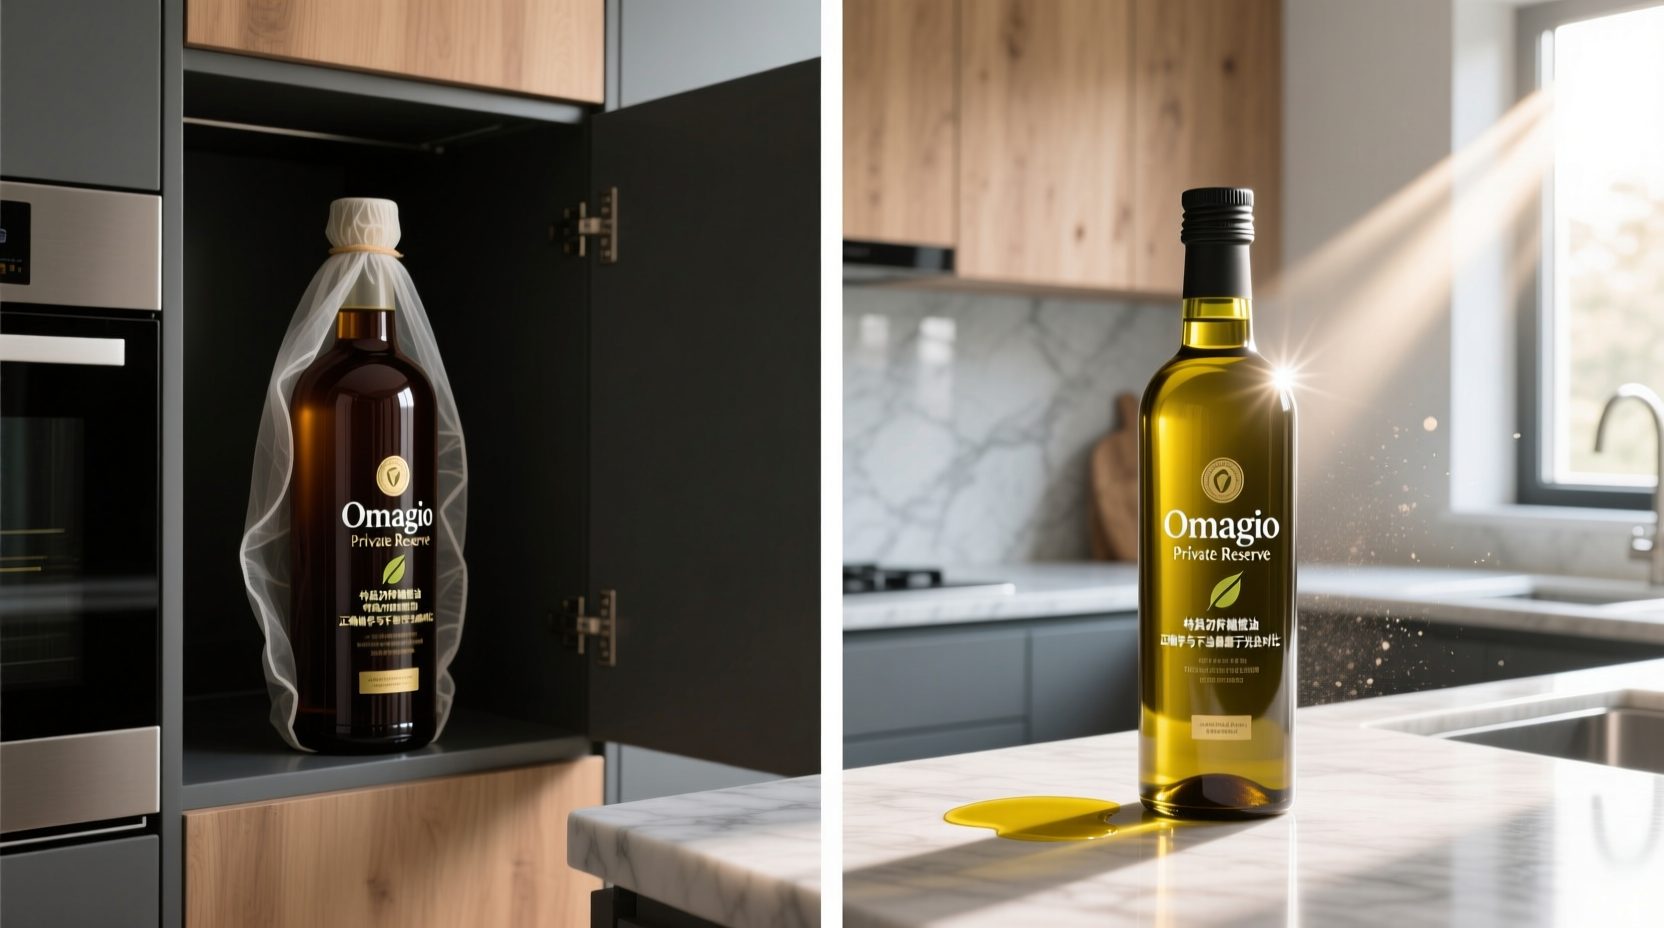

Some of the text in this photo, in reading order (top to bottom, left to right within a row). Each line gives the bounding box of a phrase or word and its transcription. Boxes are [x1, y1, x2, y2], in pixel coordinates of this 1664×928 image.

[341, 500, 433, 535] Omagio
[1164, 509, 1280, 547] Omagio
[1173, 545, 1217, 561] Private
